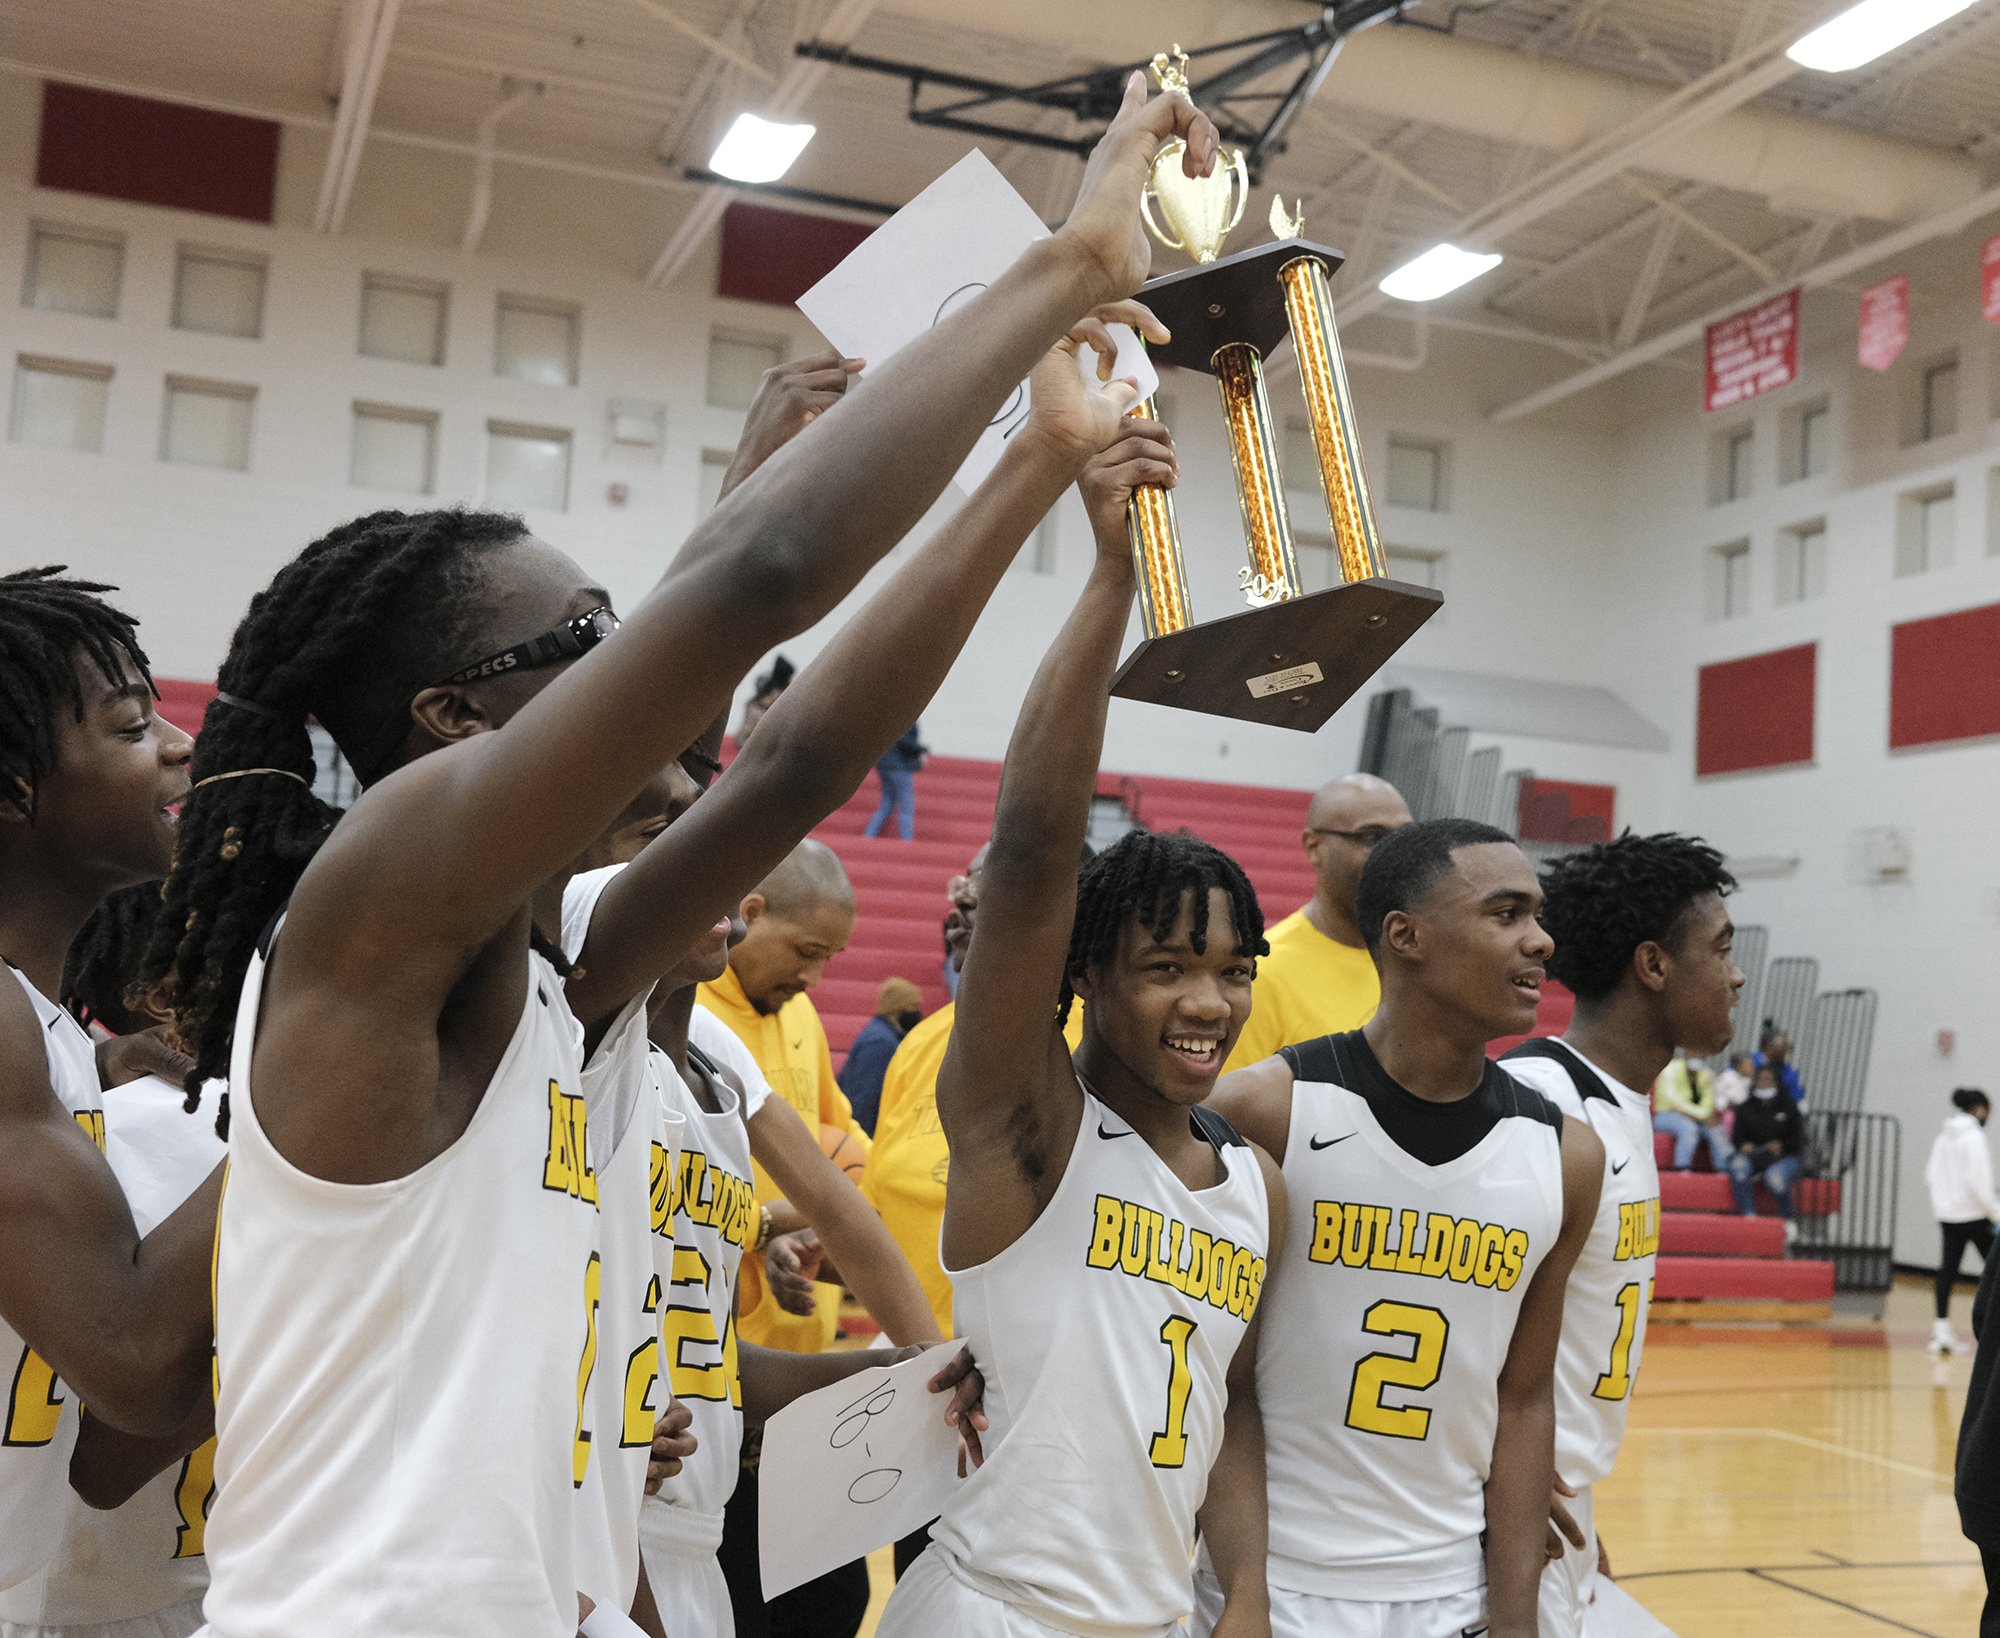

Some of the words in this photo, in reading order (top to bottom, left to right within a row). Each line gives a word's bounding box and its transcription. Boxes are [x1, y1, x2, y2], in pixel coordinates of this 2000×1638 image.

[1086, 1193, 1266, 1323] BULLDOGS
[1309, 1200, 1528, 1292] BULLDOGS
[1149, 1314, 1198, 1469] 1
[1344, 1298, 1450, 1441] 2
[829, 1377, 903, 1505] 18-0
